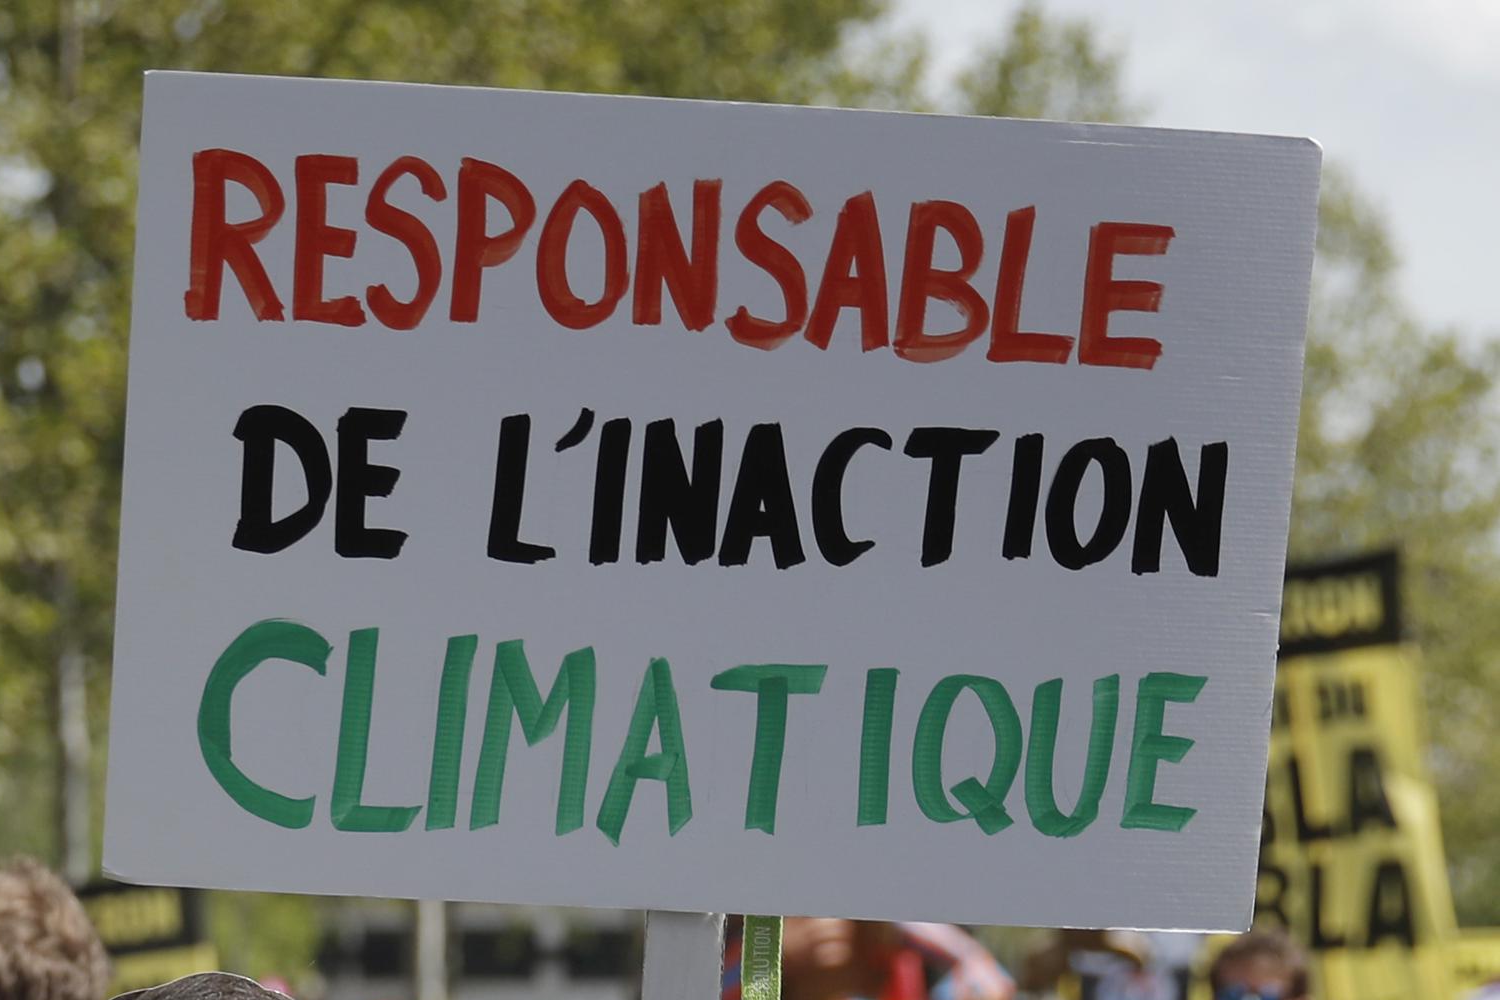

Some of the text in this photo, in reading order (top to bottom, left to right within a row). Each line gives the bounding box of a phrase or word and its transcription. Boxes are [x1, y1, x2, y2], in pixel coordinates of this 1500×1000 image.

[185, 149, 1176, 370] RESPONSABLE
[232, 404, 1229, 578] DE L'INACTION
[197, 620, 1208, 846] CLIMATIQUE
[1261, 745, 1397, 846] LA
